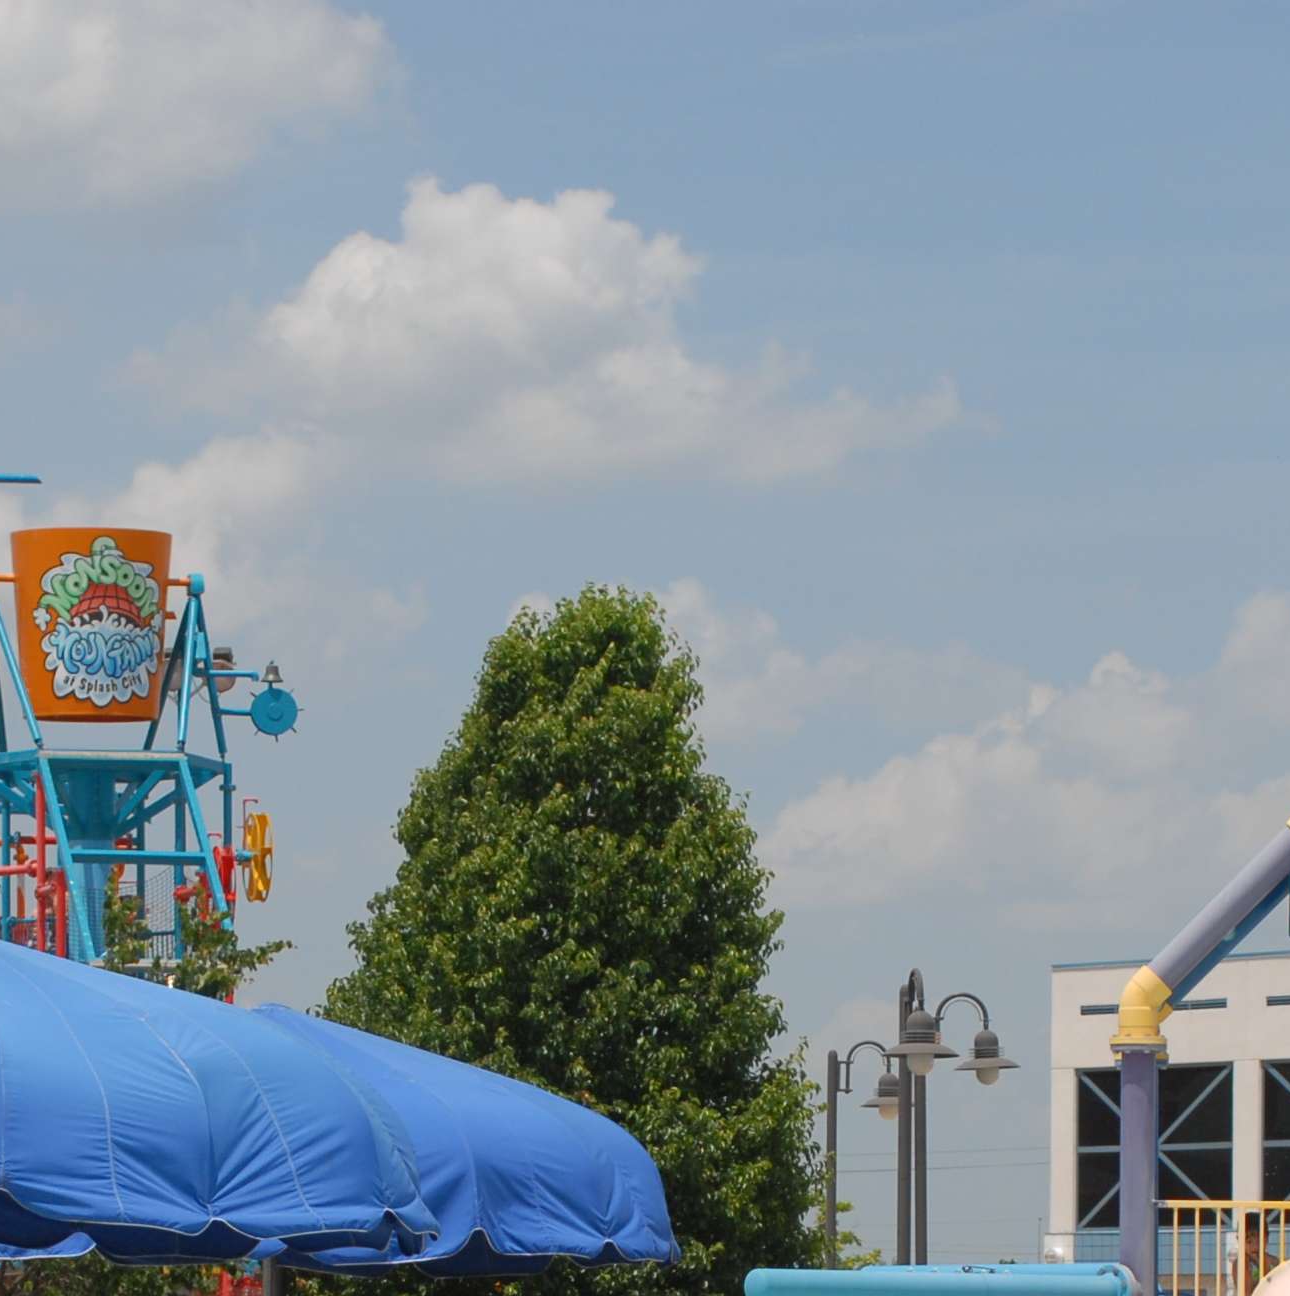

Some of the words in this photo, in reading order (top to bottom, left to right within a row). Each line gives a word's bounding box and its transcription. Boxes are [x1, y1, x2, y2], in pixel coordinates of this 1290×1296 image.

[39, 553, 160, 621] MONSOON
[63, 675, 75, 686] at
[79, 678, 118, 693] Splash
[121, 674, 143, 688] City
